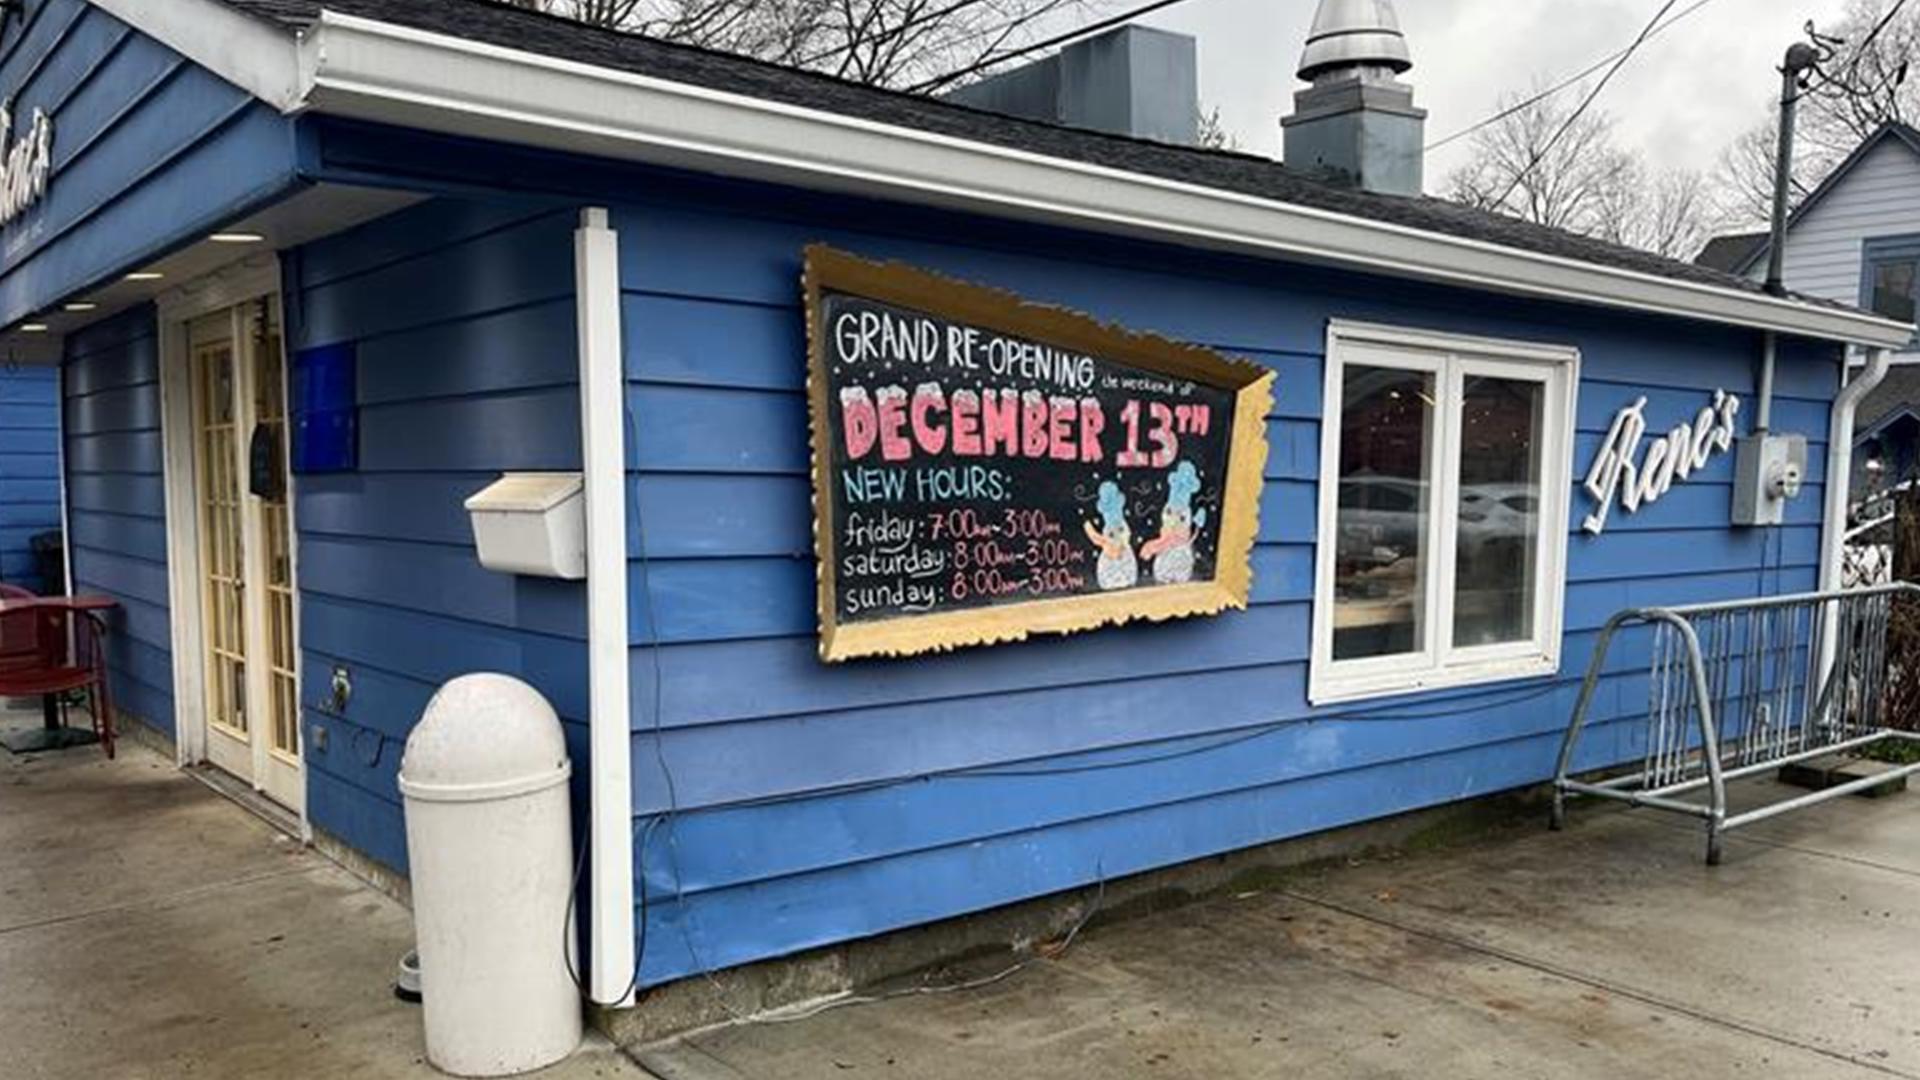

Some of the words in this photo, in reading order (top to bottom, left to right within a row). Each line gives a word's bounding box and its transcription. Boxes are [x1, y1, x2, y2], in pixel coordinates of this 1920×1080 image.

[836, 312, 939, 363] GRAND
[948, 326, 1095, 388] RE-OPENING
[1121, 377, 1175, 396] weekend
[840, 381, 1105, 462] DECEMBER
[1116, 399, 1210, 468] 13TH
[1583, 387, 1741, 535] Rene's
[843, 466, 907, 502] NEW
[917, 465, 1012, 501] HOURS:
[844, 509, 925, 553] friday:
[846, 578, 944, 613] sunday:
